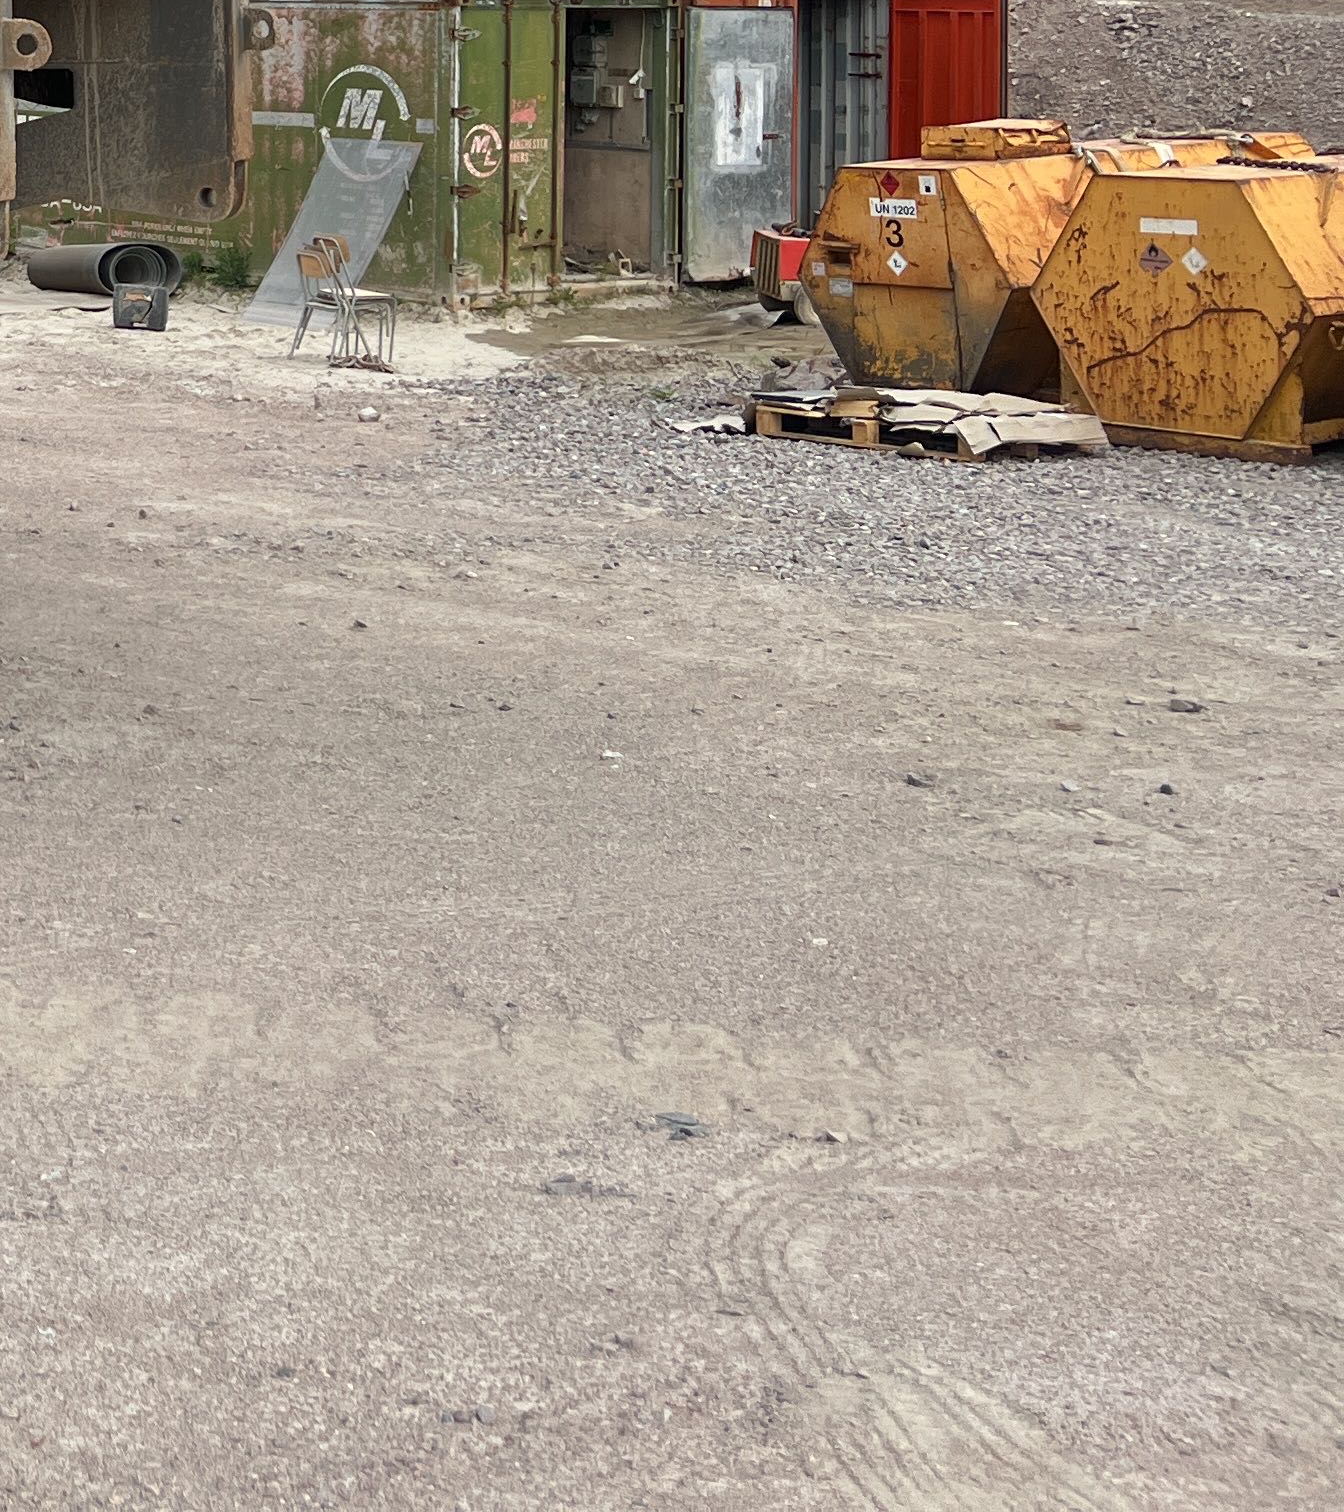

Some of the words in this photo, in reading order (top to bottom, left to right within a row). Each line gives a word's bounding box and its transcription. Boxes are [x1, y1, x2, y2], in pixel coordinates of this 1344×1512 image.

[875, 203, 890, 214] UN
[893, 205, 915, 216] 1202
[885, 219, 904, 248] 3
